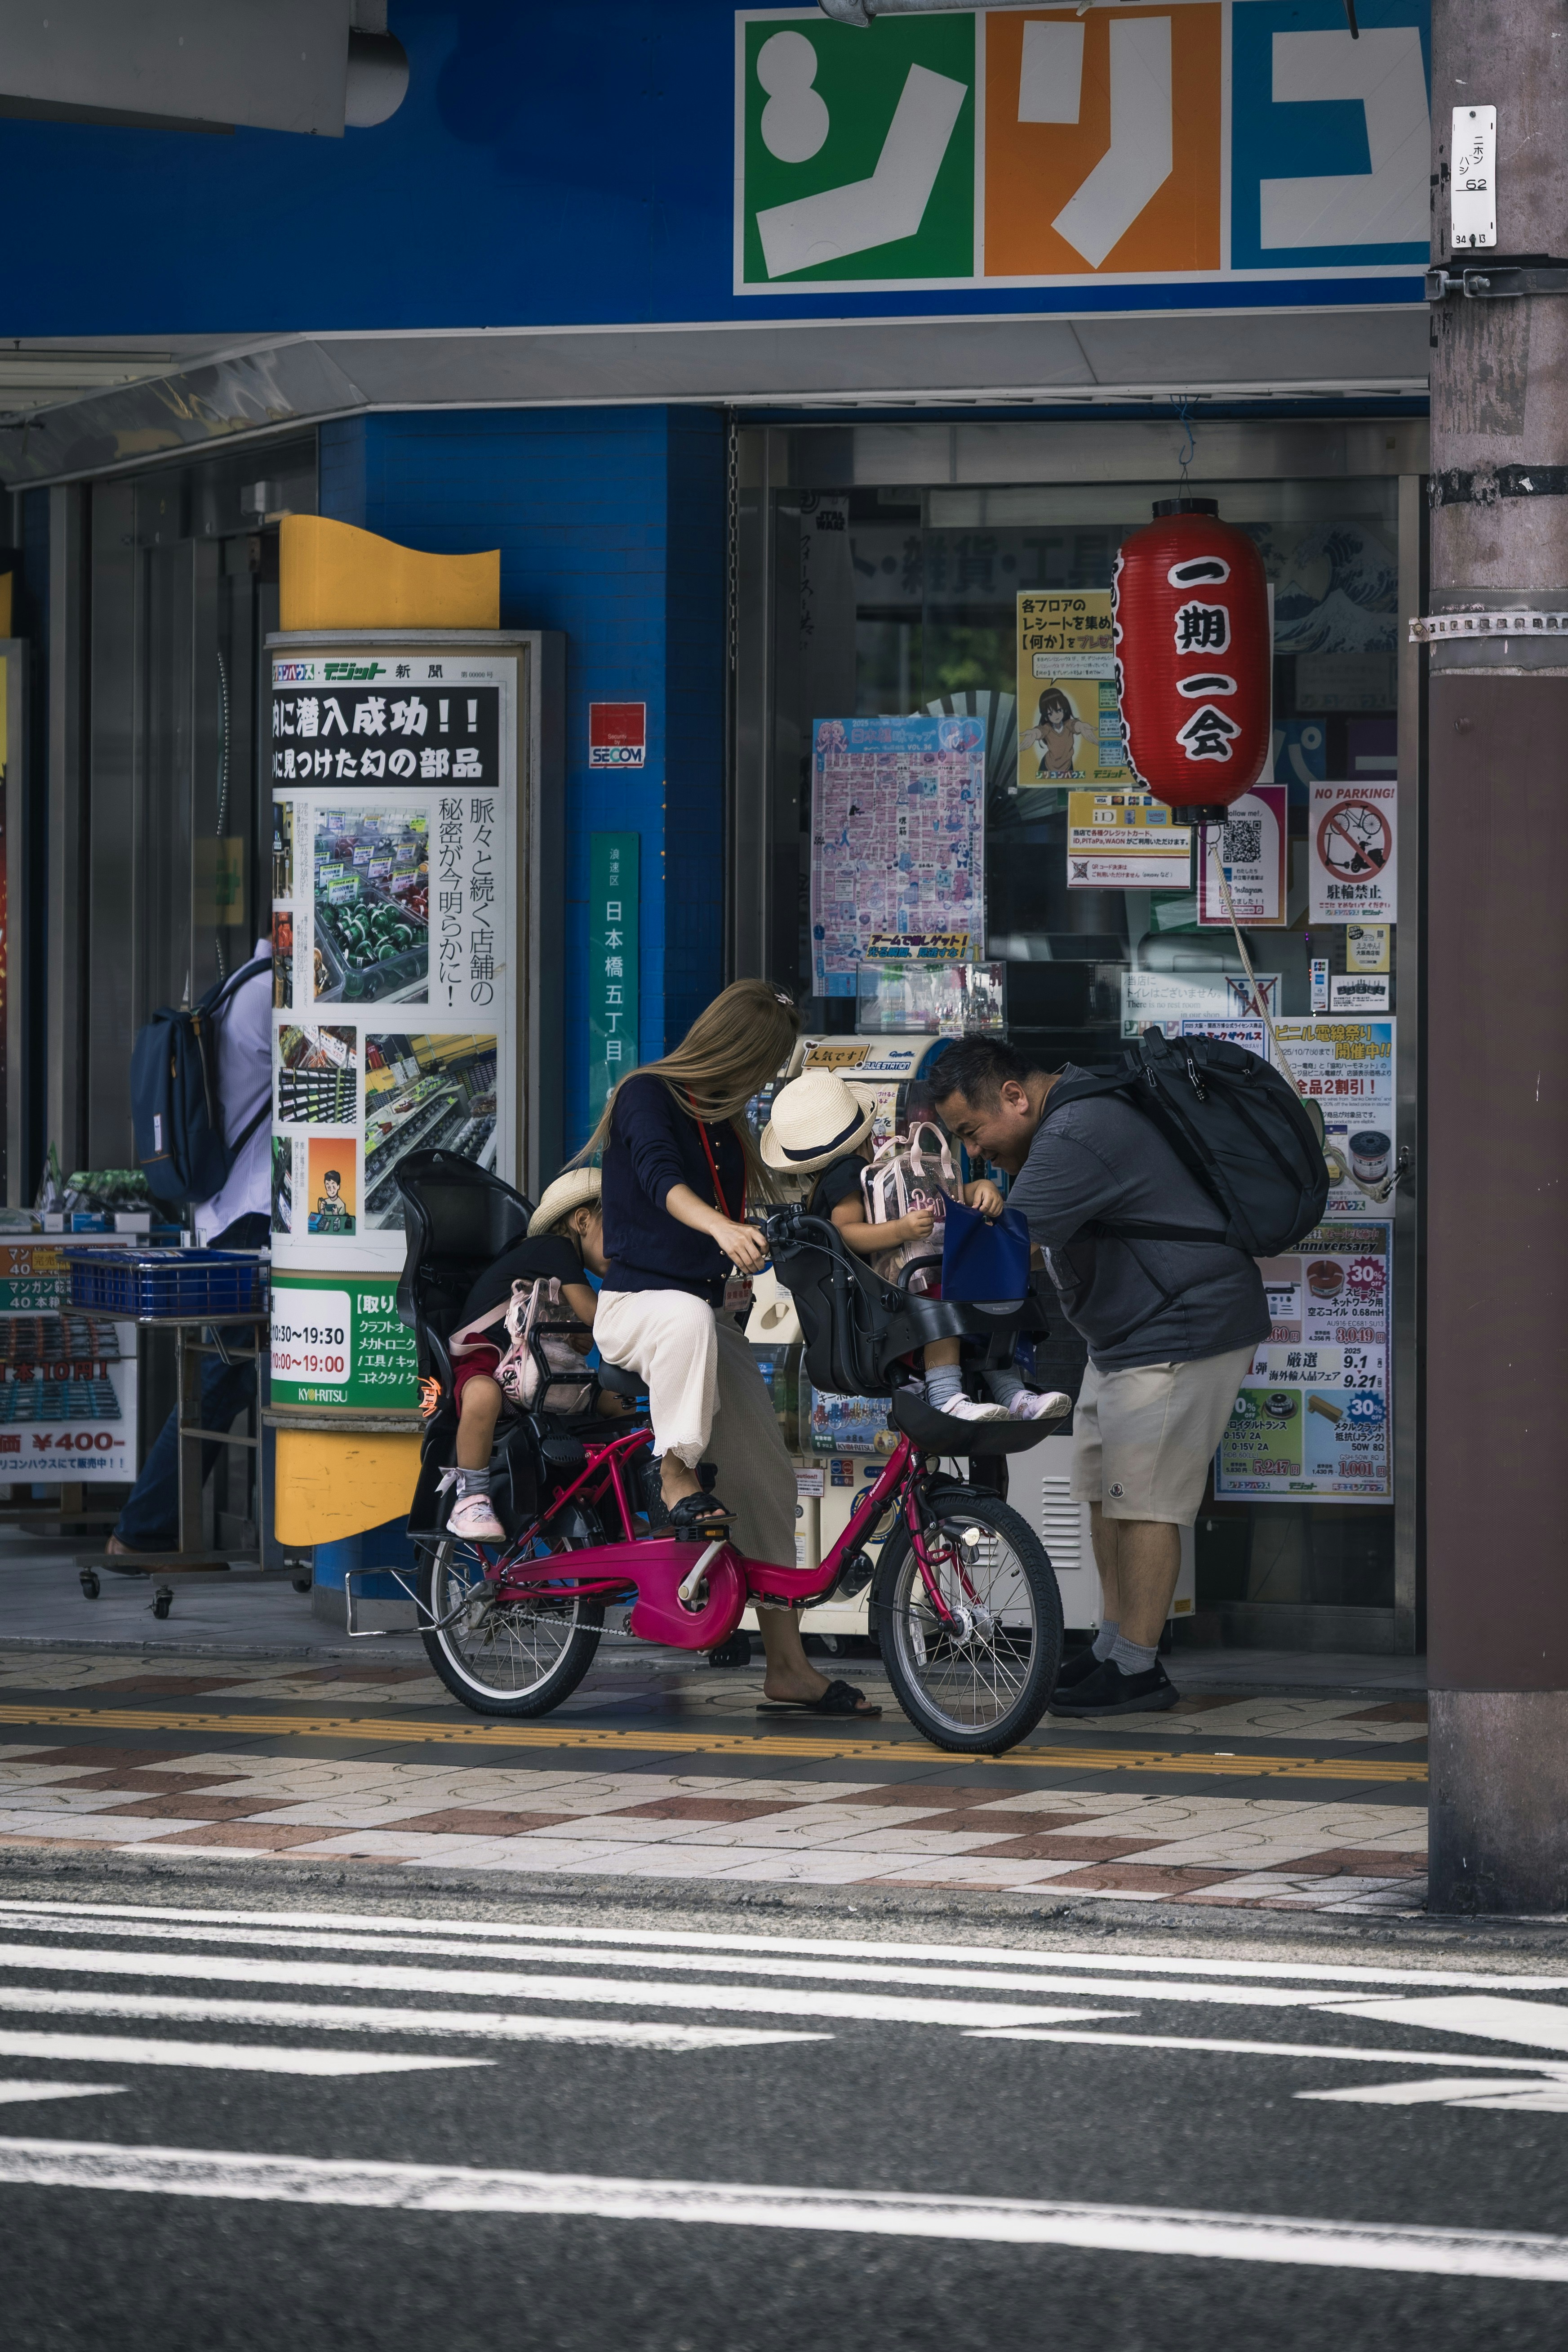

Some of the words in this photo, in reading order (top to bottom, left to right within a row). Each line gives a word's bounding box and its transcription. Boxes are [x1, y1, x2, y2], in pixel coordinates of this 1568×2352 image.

[1474, 136, 1484, 165] ニホン
[1460, 155, 1474, 175] バシ
[1466, 179, 1487, 190] 62
[1022, 599, 1086, 613] 各フロアの
[1174, 560, 1236, 758] 一期一会
[324, 663, 386, 680] デジット
[593, 748, 641, 762] SECOM
[1035, 771, 1085, 779] シリコンハウス
[1093, 770, 1127, 778] デジット
[1315, 789, 1333, 799] NO
[1336, 788, 1395, 799] PARKING!
[1094, 812, 1114, 822] iD
[609, 848, 619, 886] 浪速区
[1234, 886, 1263, 896] Instagram
[1327, 885, 1381, 899] 駐輪禁止
[439, 798, 463, 1007] 秘密が今明らかに！
[470, 798, 494, 1007] 脈々と続く店舗の
[867, 946, 966, 958] 光る瞬間、見逃すな！
[605, 902, 623, 1061] 日本橋五丁目
[1127, 976, 1156, 986] 当店に
[1127, 988, 1221, 998] トイレはございません。
[1126, 1000, 1146, 1008] There
[1275, 1025, 1371, 1042] ビニル電線祭り
[808, 1050, 864, 1061] 人気です！
[881, 1062, 910, 1070] STATION
[1296, 1079, 1375, 1095] 全品2割引！
[1292, 1241, 1377, 1254] anniversary
[1351, 1266, 1382, 1281] 30%
[1346, 1288, 1384, 1298] スピーカー
[357, 1294, 398, 1314] 【取り
[1331, 1298, 1384, 1307] ネットワーク用
[1307, 1307, 1348, 1317] 空芯コイル
[1352, 1308, 1384, 1316] 0.68mH
[359, 1337, 416, 1350] メカトロニク
[1286, 1352, 1318, 1368] 厳選
[1343, 1355, 1368, 1369] 9.1
[1269, 1370, 1341, 1382] 海外輸入品フェア
[1343, 1374, 1377, 1388] 9.21
[298, 1388, 347, 1403] KYOHRITSU
[1233, 1397, 1256, 1414] 0%
[1351, 1400, 1382, 1415] 30%
[1333, 1423, 1384, 1431] メタルクラッド
[1335, 1432, 1384, 1442] 抵抗(Jランク)
[837, 1443, 873, 1452] KYOHRITSU
[869, 1472, 886, 1497] Panasonic
